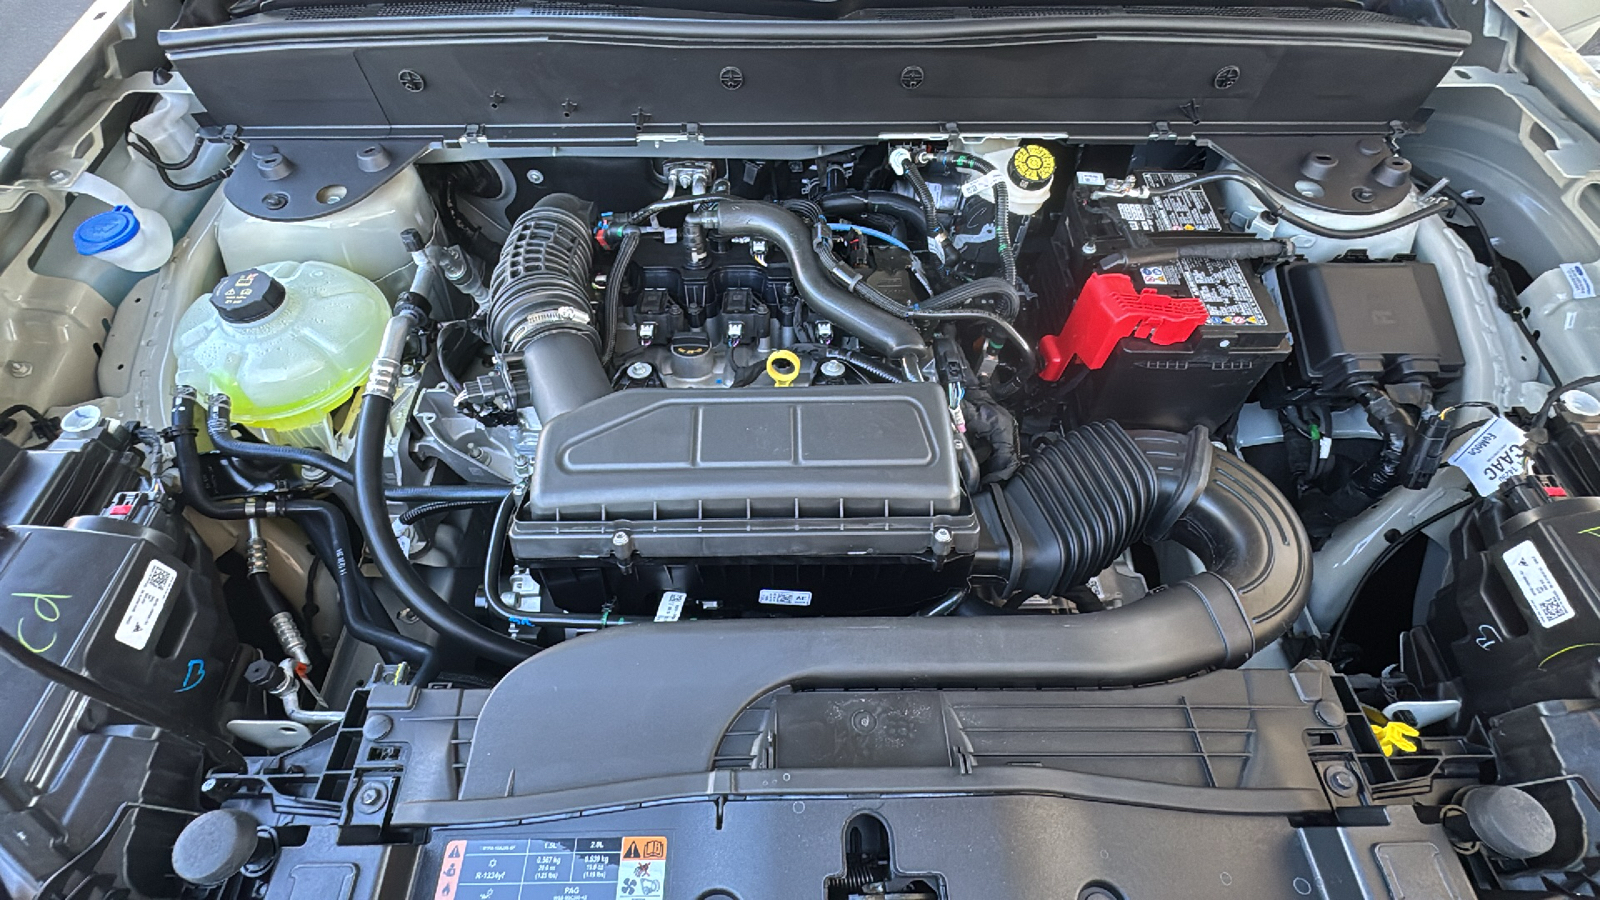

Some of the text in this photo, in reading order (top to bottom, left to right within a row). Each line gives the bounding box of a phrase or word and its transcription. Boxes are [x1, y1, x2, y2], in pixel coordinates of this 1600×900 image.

[1483, 444, 1525, 481] CAAC
[589, 841, 604, 849] 2.0L
[553, 856, 562, 866] kg
[601, 854, 609, 865] kg
[564, 886, 580, 894] PAG
